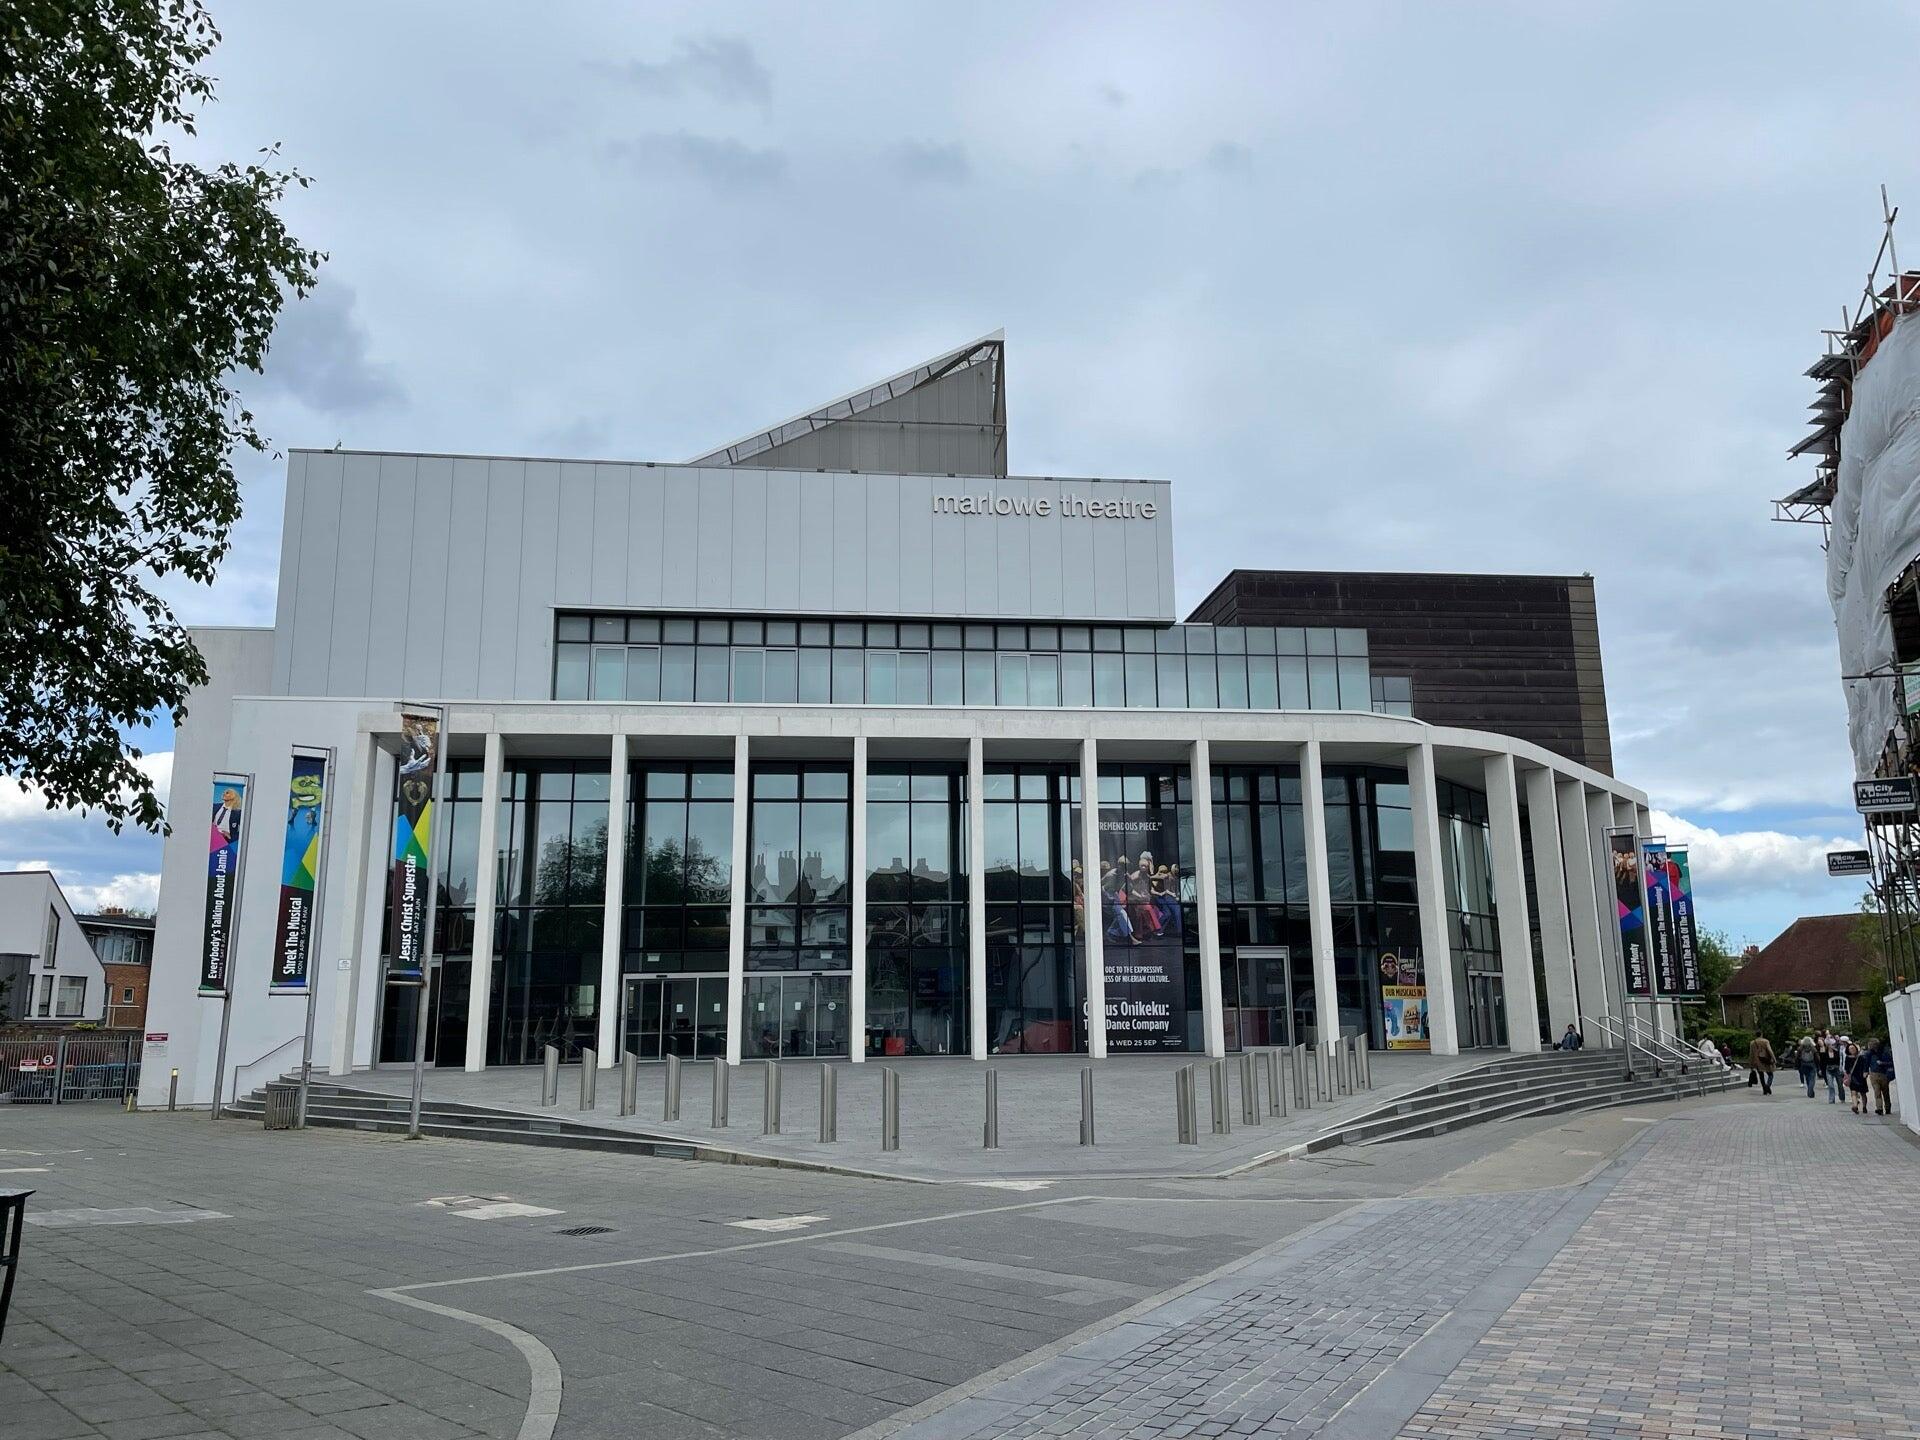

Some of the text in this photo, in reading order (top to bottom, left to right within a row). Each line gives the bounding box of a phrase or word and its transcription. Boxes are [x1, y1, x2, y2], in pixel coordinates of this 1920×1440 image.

[933, 490, 1157, 519] marlowe theatre
[1875, 784, 1893, 792] City
[1099, 822, 1138, 831] REMENDOUS
[216, 849, 228, 873] Jamie
[214, 874, 226, 898] About
[212, 900, 225, 928] Talking
[399, 854, 416, 961] Jesus Christ Superstar
[1679, 901, 1687, 916] Class
[415, 912, 420, 920] 22
[1680, 916, 1688, 926] The
[283, 898, 302, 974] Shrek The Musical
[1684, 949, 1692, 960] The
[1134, 966, 1163, 974] EXPRESSIVE
[1630, 943, 1642, 988] The Full Monty
[1686, 967, 1694, 979] Boy
[1687, 979, 1695, 990] The
[1106, 1018, 1170, 1032] Dance Company
